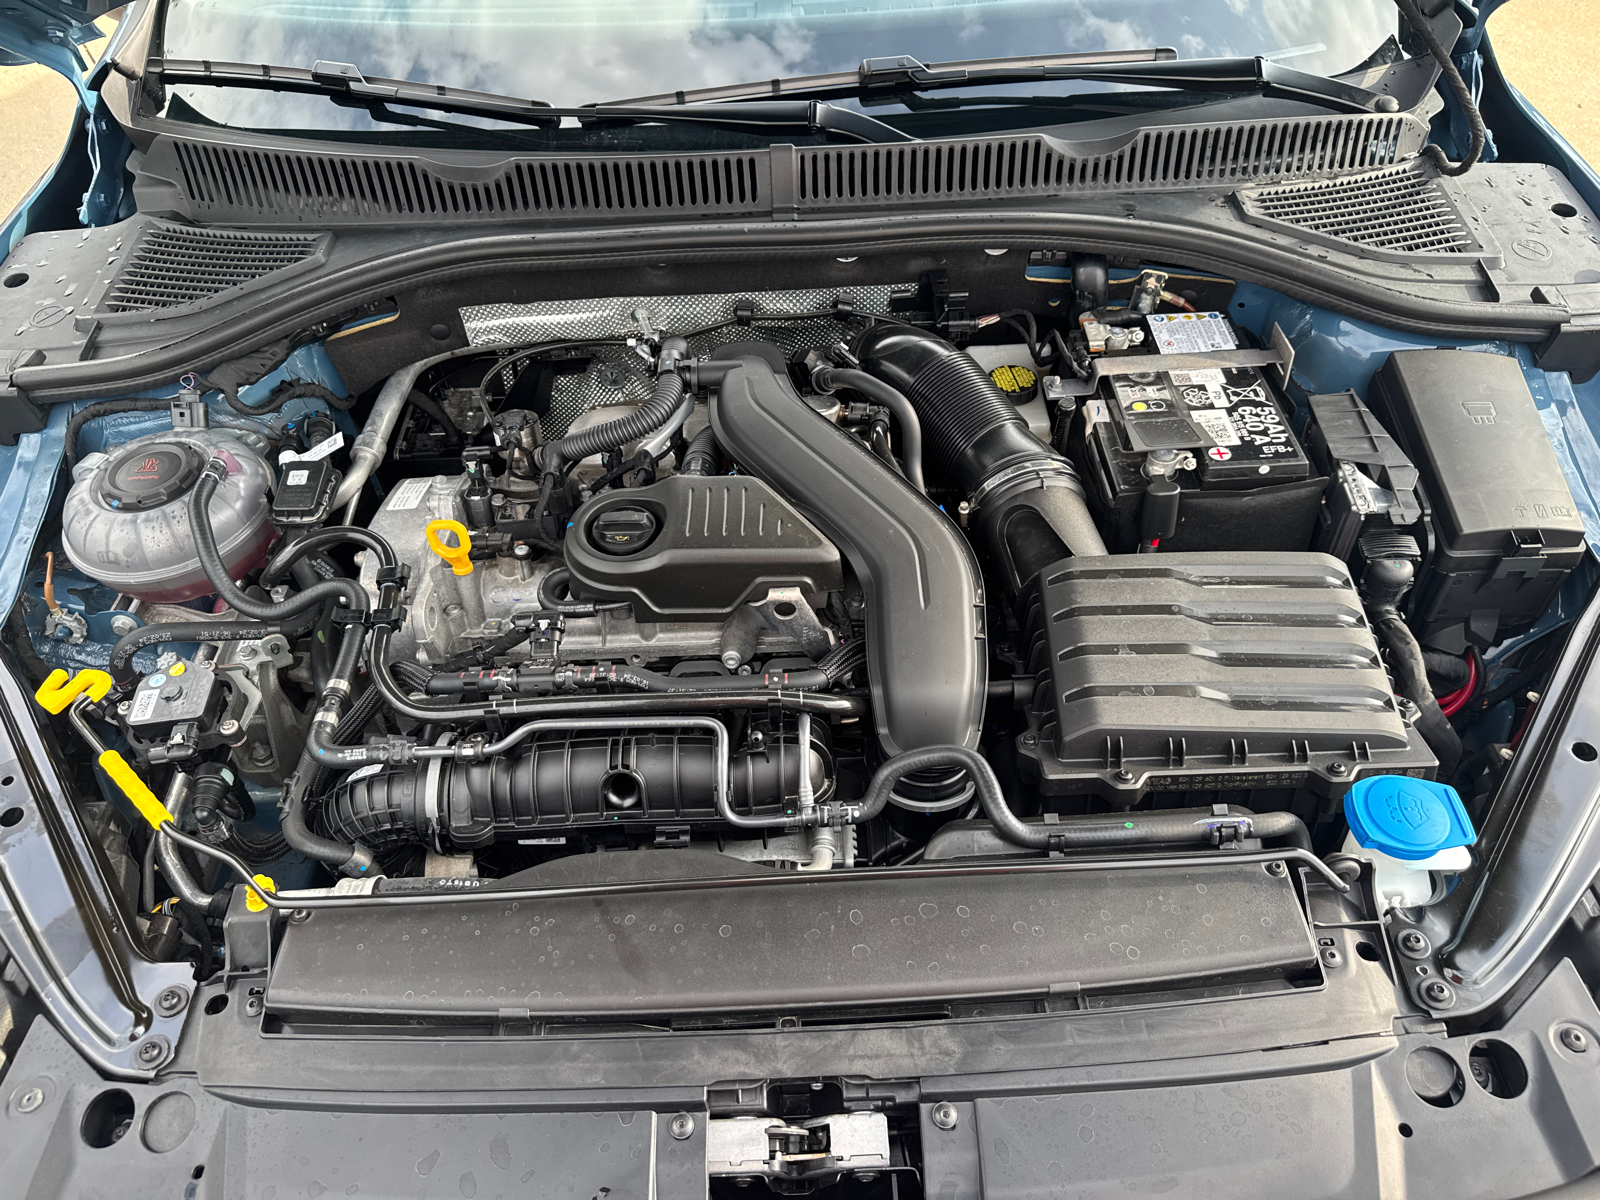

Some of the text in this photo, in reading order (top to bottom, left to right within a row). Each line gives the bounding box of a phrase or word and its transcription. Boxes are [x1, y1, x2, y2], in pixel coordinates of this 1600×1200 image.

[1211, 390, 1222, 400] Pb
[1238, 406, 1264, 432] 640
[1256, 406, 1288, 442] 59Ah
[1250, 434, 1271, 446] A
[1262, 445, 1294, 453] EFB+
